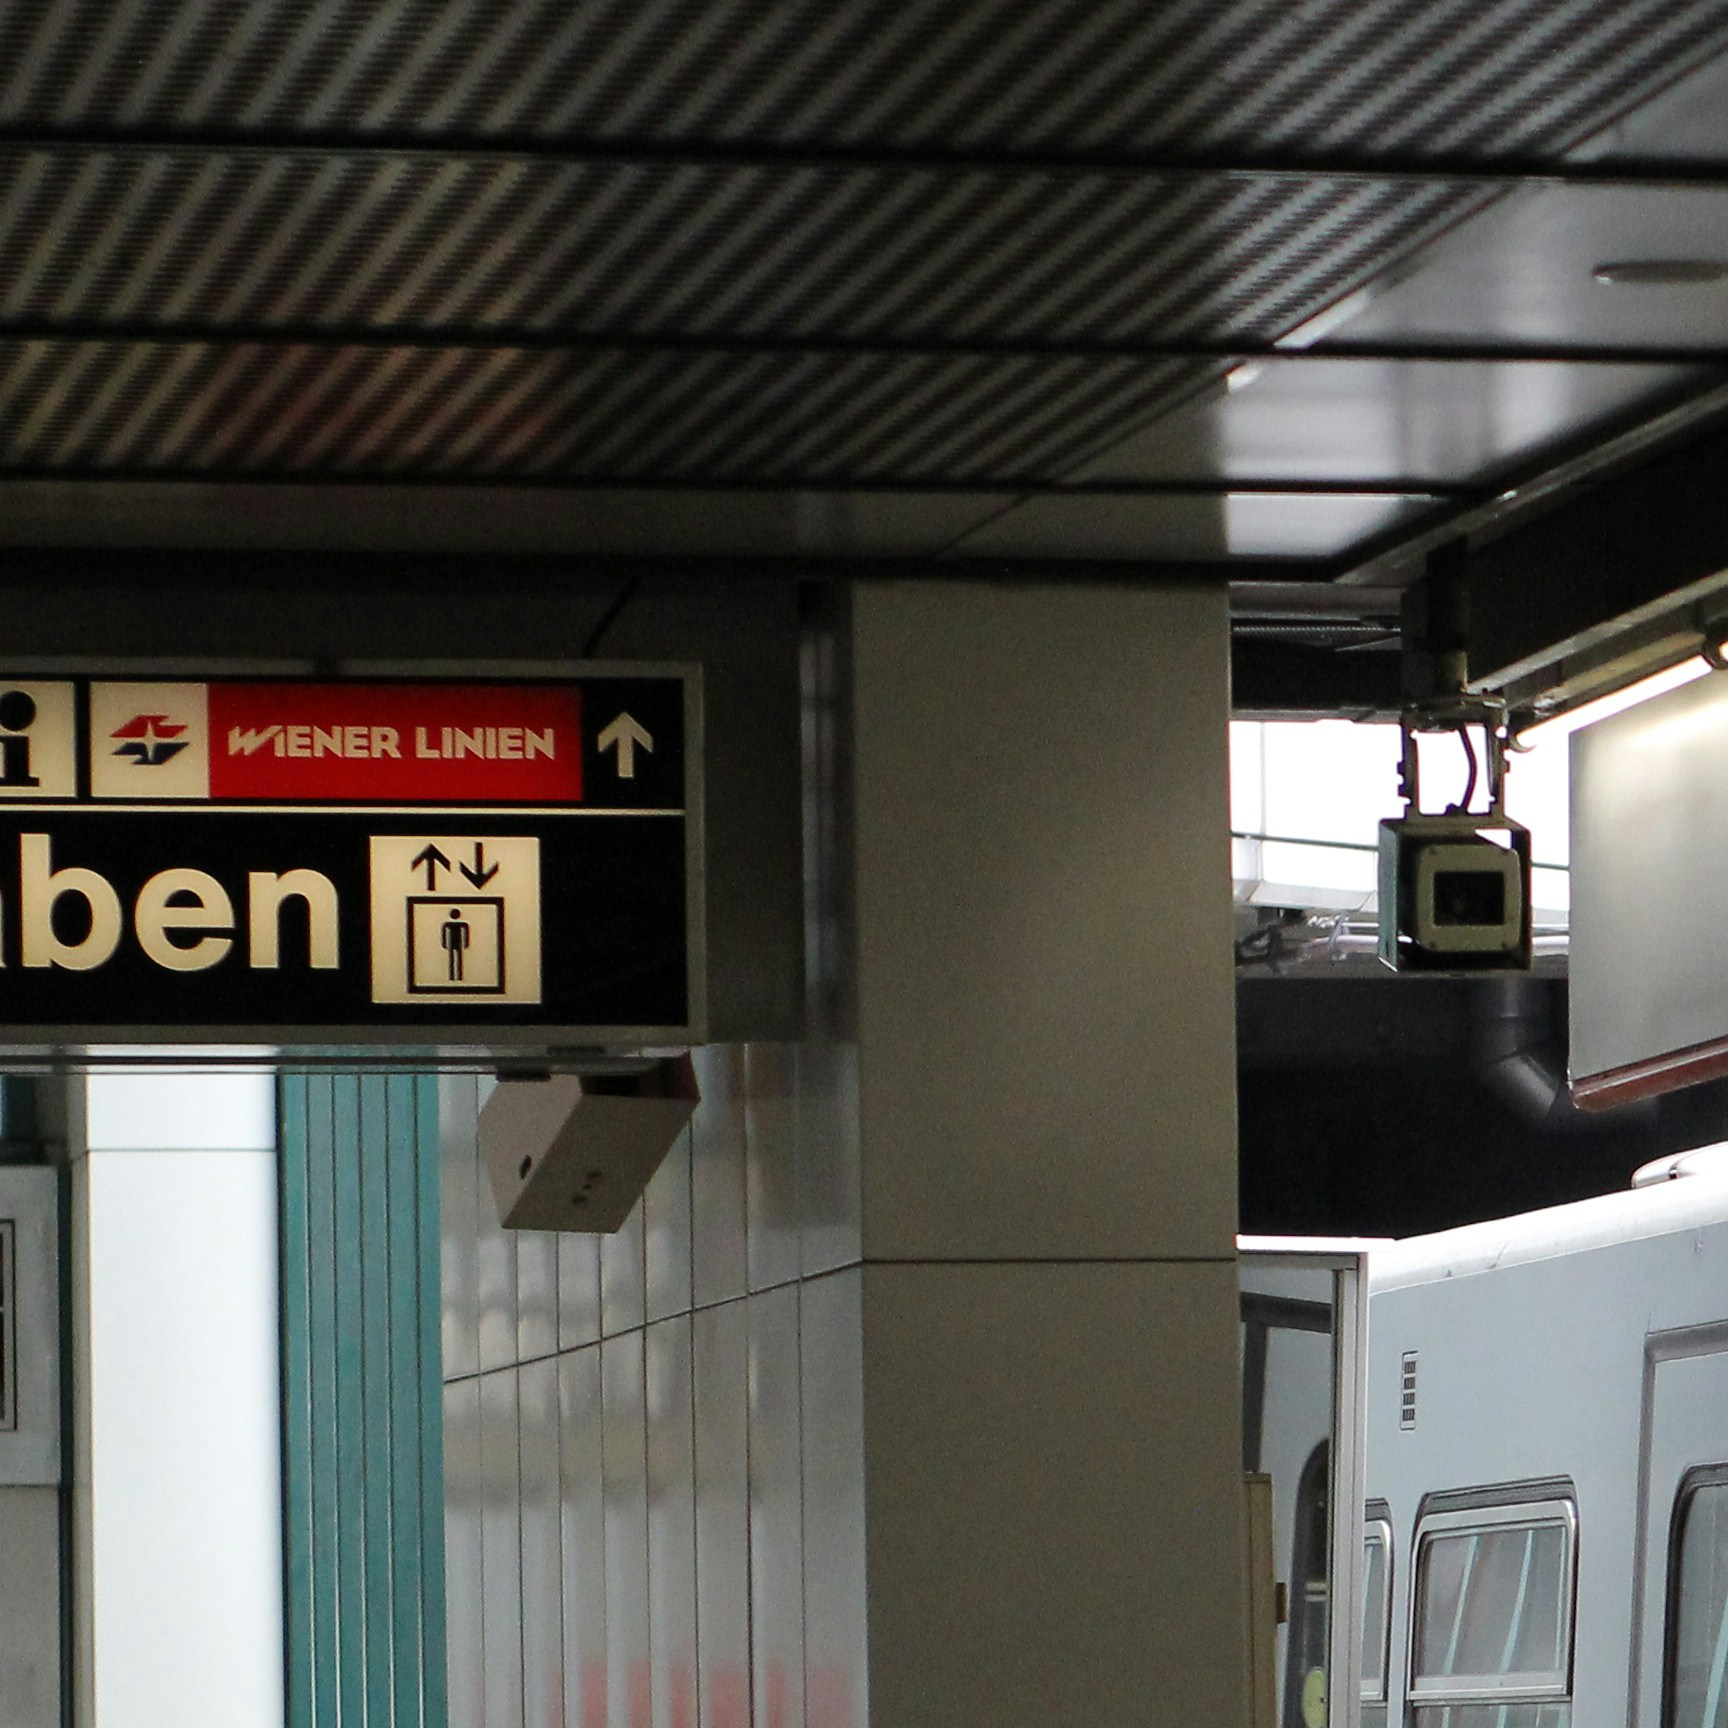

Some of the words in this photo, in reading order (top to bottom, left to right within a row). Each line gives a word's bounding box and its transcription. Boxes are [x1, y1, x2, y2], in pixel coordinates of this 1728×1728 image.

[228, 725, 402, 758] WIENER
[415, 727, 555, 760] LINIEN
[0, 833, 340, 971] ben
